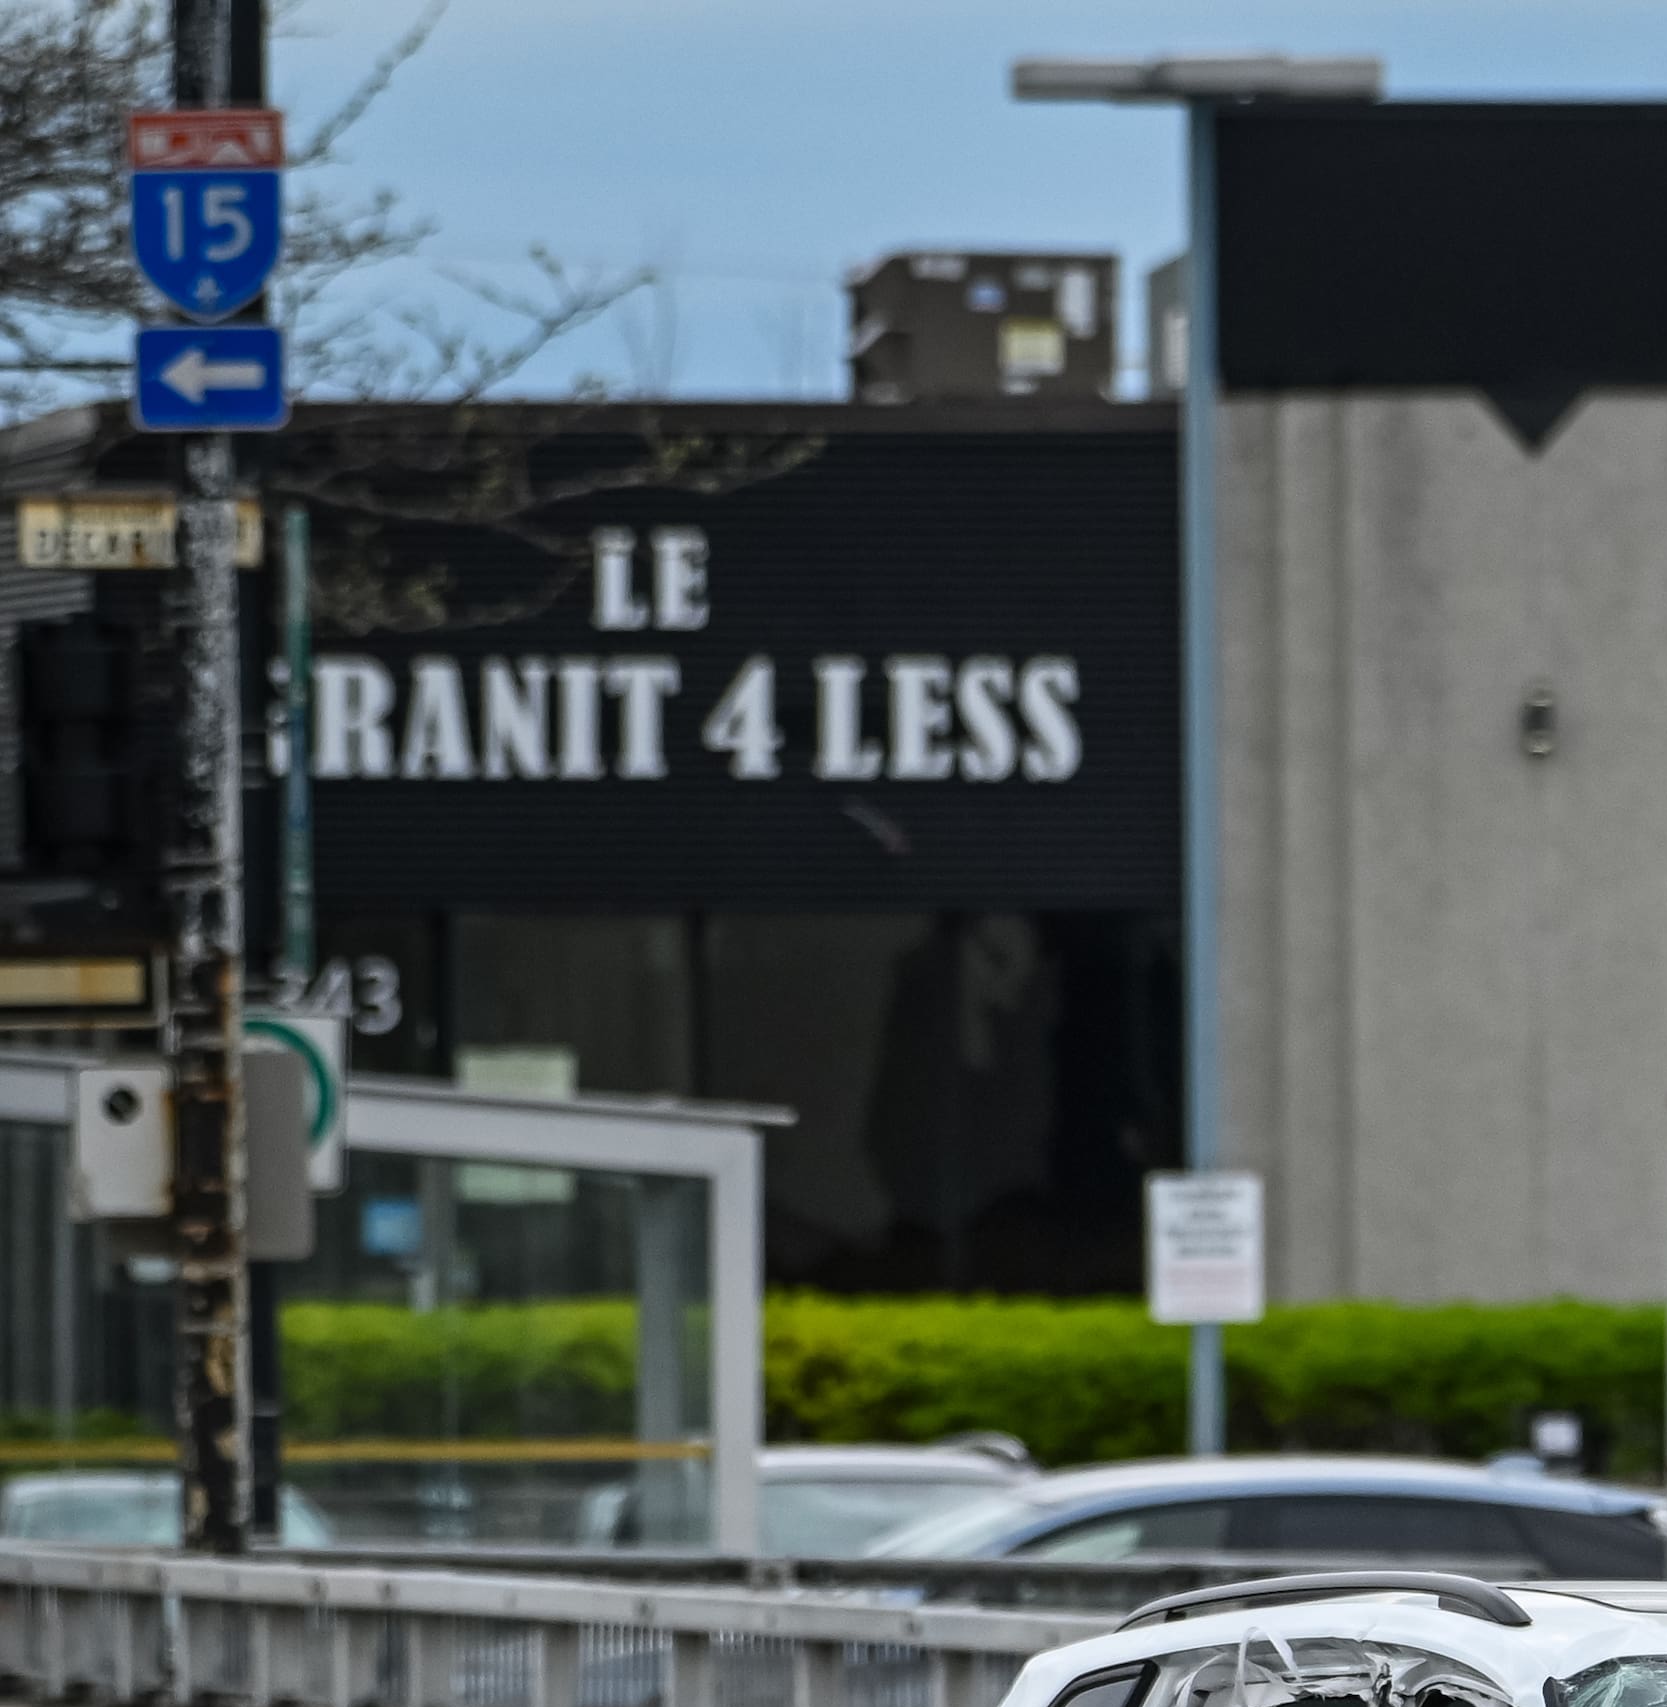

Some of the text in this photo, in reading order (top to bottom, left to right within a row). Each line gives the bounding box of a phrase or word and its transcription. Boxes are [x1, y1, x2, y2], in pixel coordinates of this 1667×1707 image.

[162, 185, 254, 262] 15
[590, 525, 711, 633] LE
[701, 652, 785, 781] 4
[813, 652, 1084, 783] LESS
